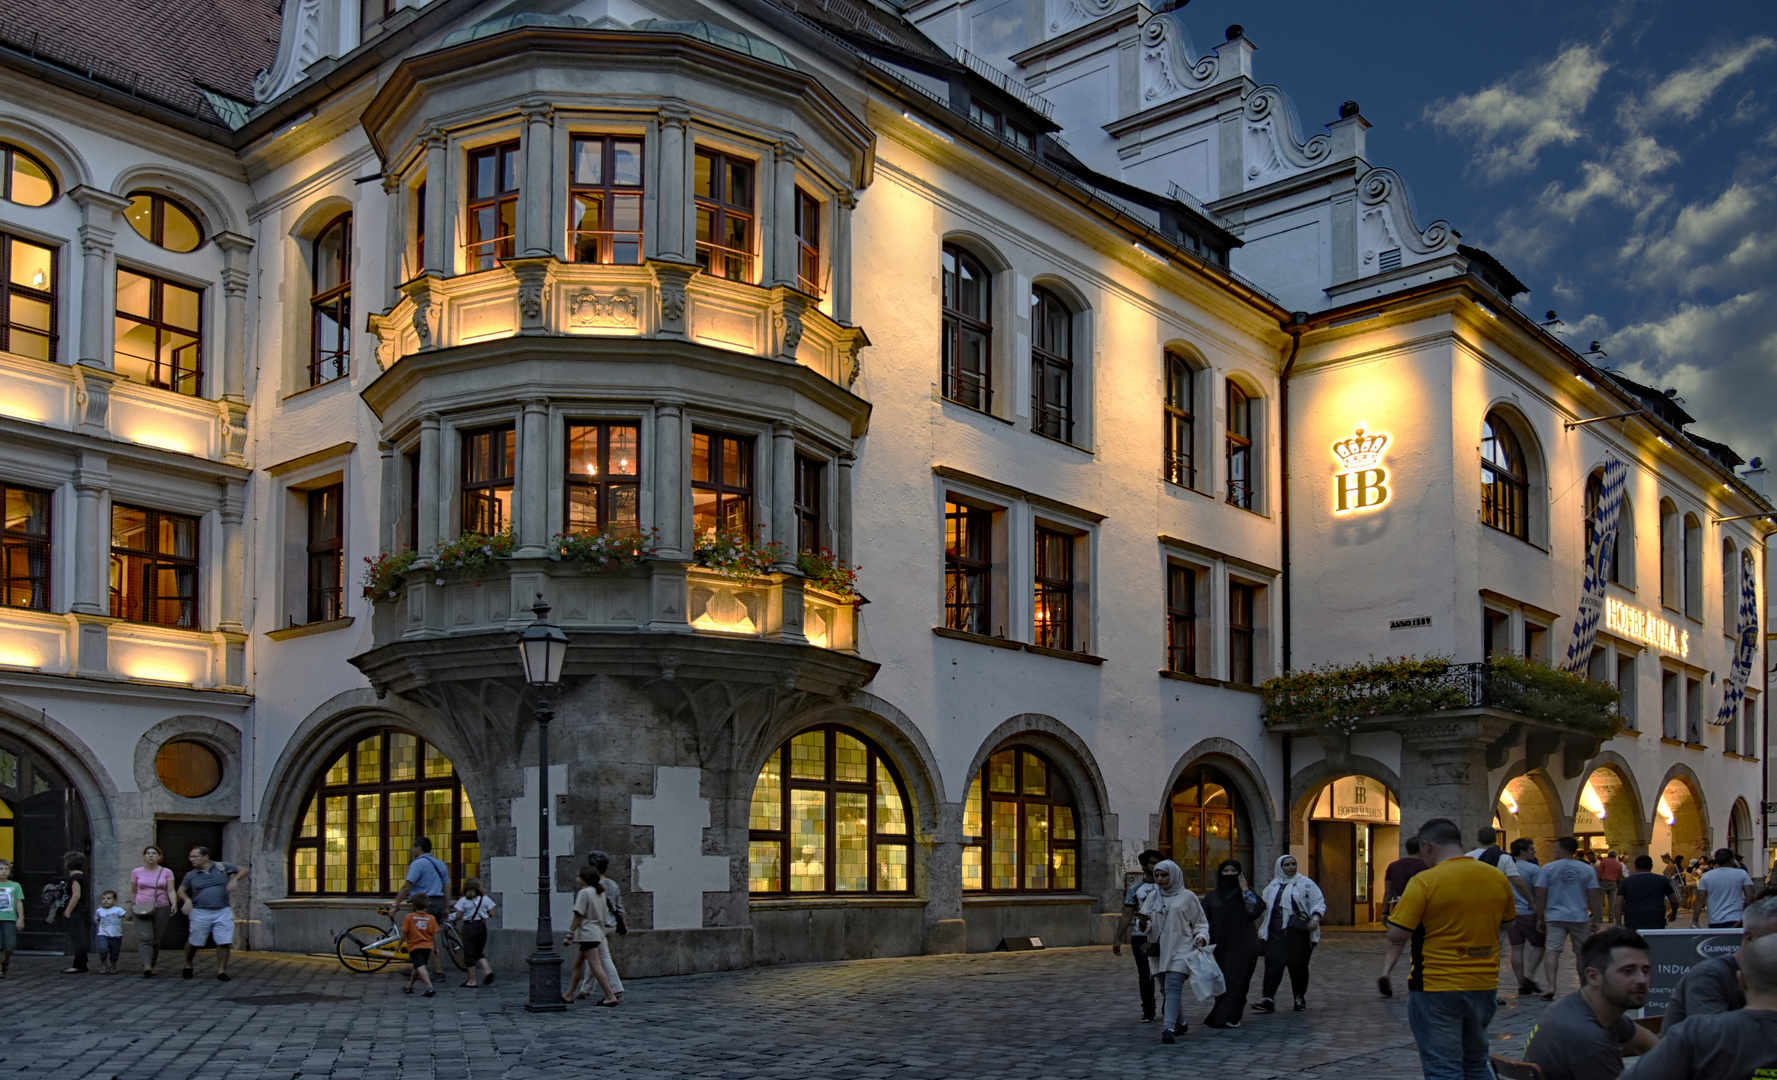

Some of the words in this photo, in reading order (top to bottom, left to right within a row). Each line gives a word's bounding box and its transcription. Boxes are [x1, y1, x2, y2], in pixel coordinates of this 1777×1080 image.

[1335, 467, 1389, 512] HB
[1390, 619, 1411, 628] ANNO
[1412, 617, 1431, 626] 1589
[1354, 786, 1367, 804] HB
